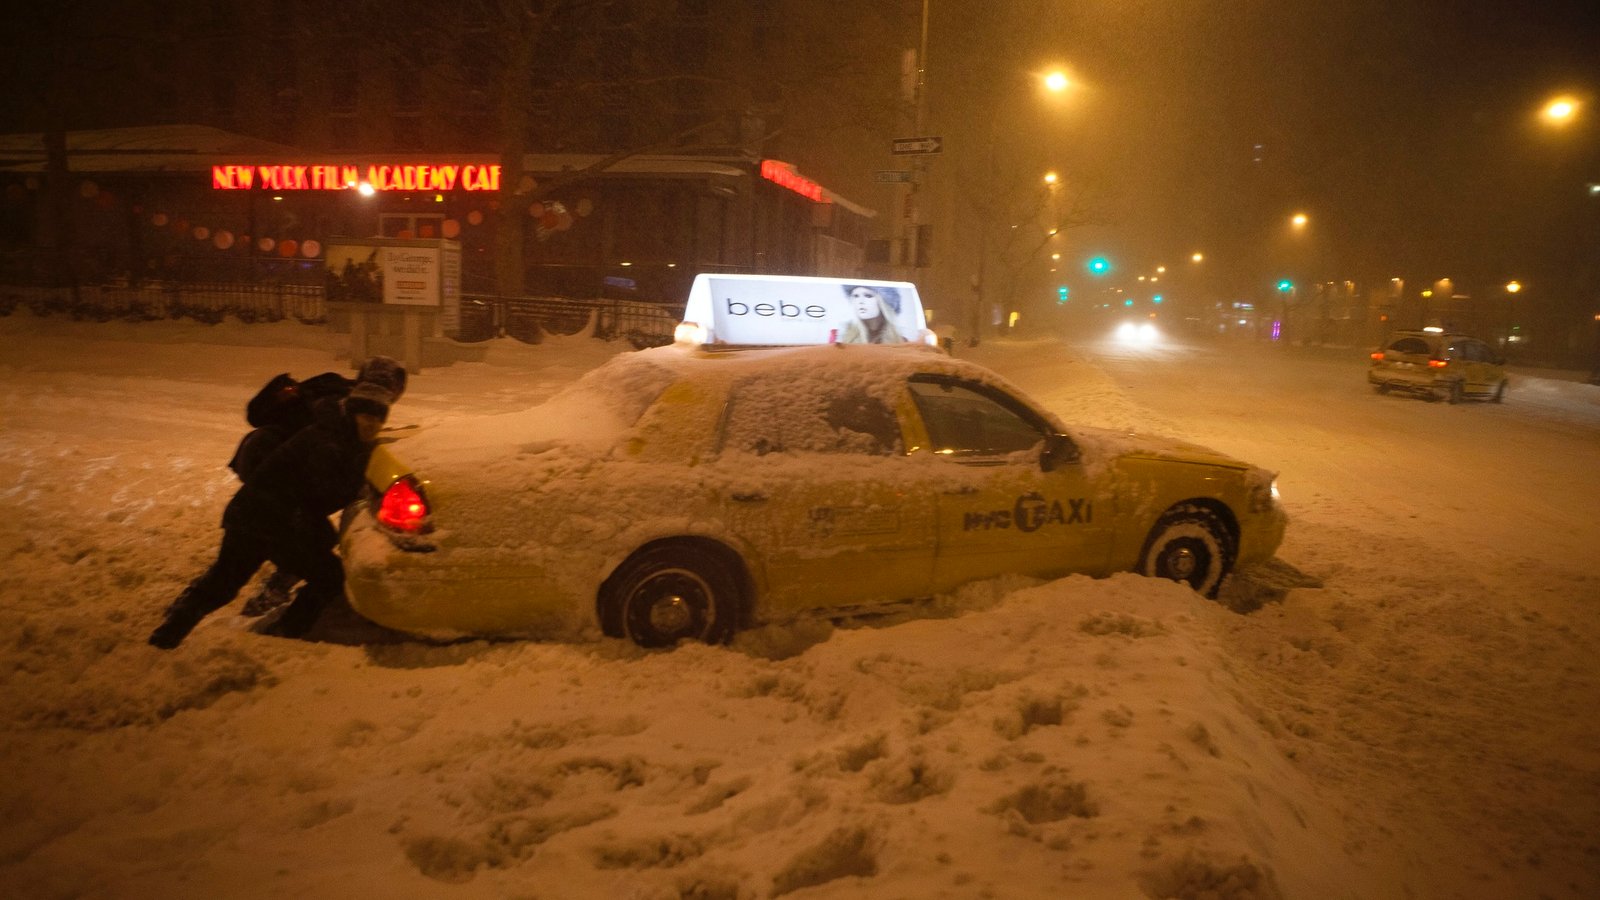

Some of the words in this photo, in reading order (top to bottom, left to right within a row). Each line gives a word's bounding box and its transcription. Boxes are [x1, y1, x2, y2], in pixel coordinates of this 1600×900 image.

[213, 165, 255, 190] NEW
[258, 165, 309, 190] YORK
[311, 165, 358, 190] FILM
[366, 165, 460, 190] ACADEMY
[726, 298, 826, 318] bebe
[963, 510, 1011, 531] NYC
[1013, 492, 1093, 533] TAXI
